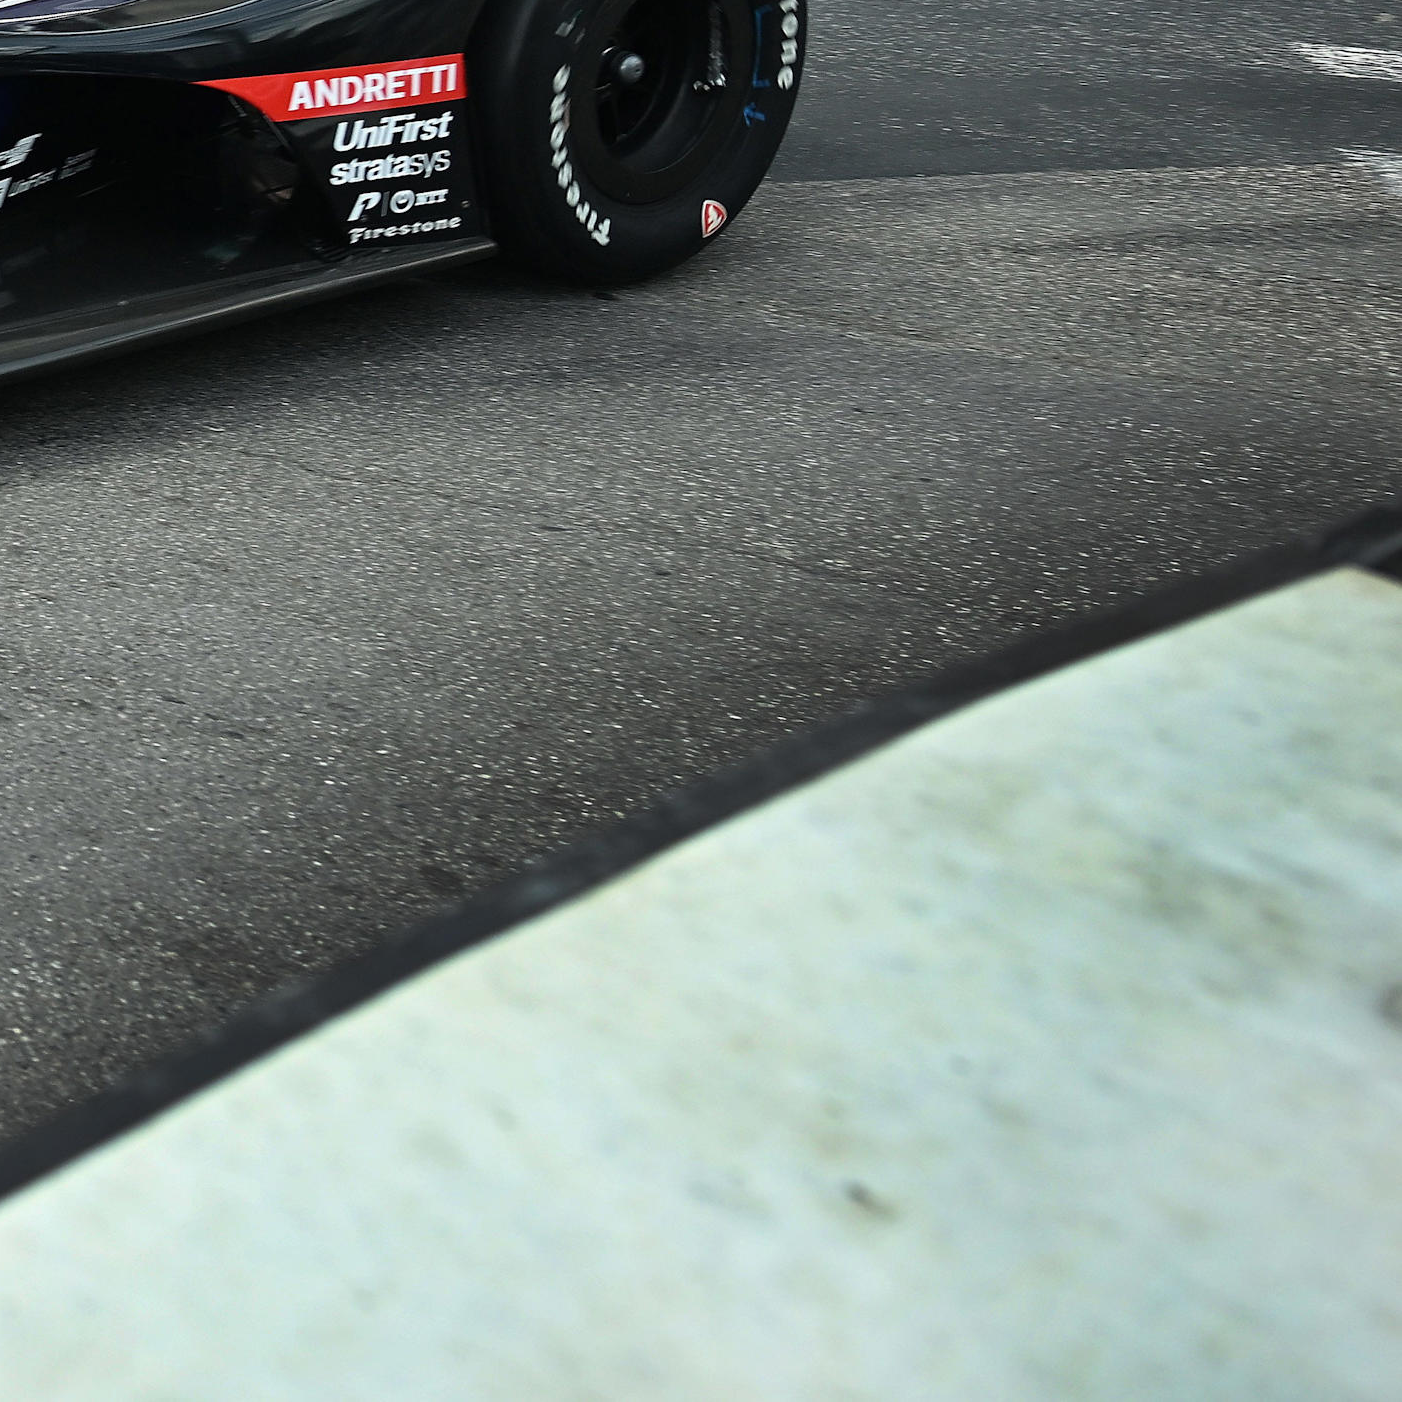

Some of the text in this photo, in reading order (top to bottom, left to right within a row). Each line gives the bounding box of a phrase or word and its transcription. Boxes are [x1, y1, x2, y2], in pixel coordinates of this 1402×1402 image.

[288, 63, 458, 111] ANDRETTI
[333, 111, 455, 152] UniFirst
[328, 149, 452, 186] stratasys
[348, 216, 463, 244] Firestone
